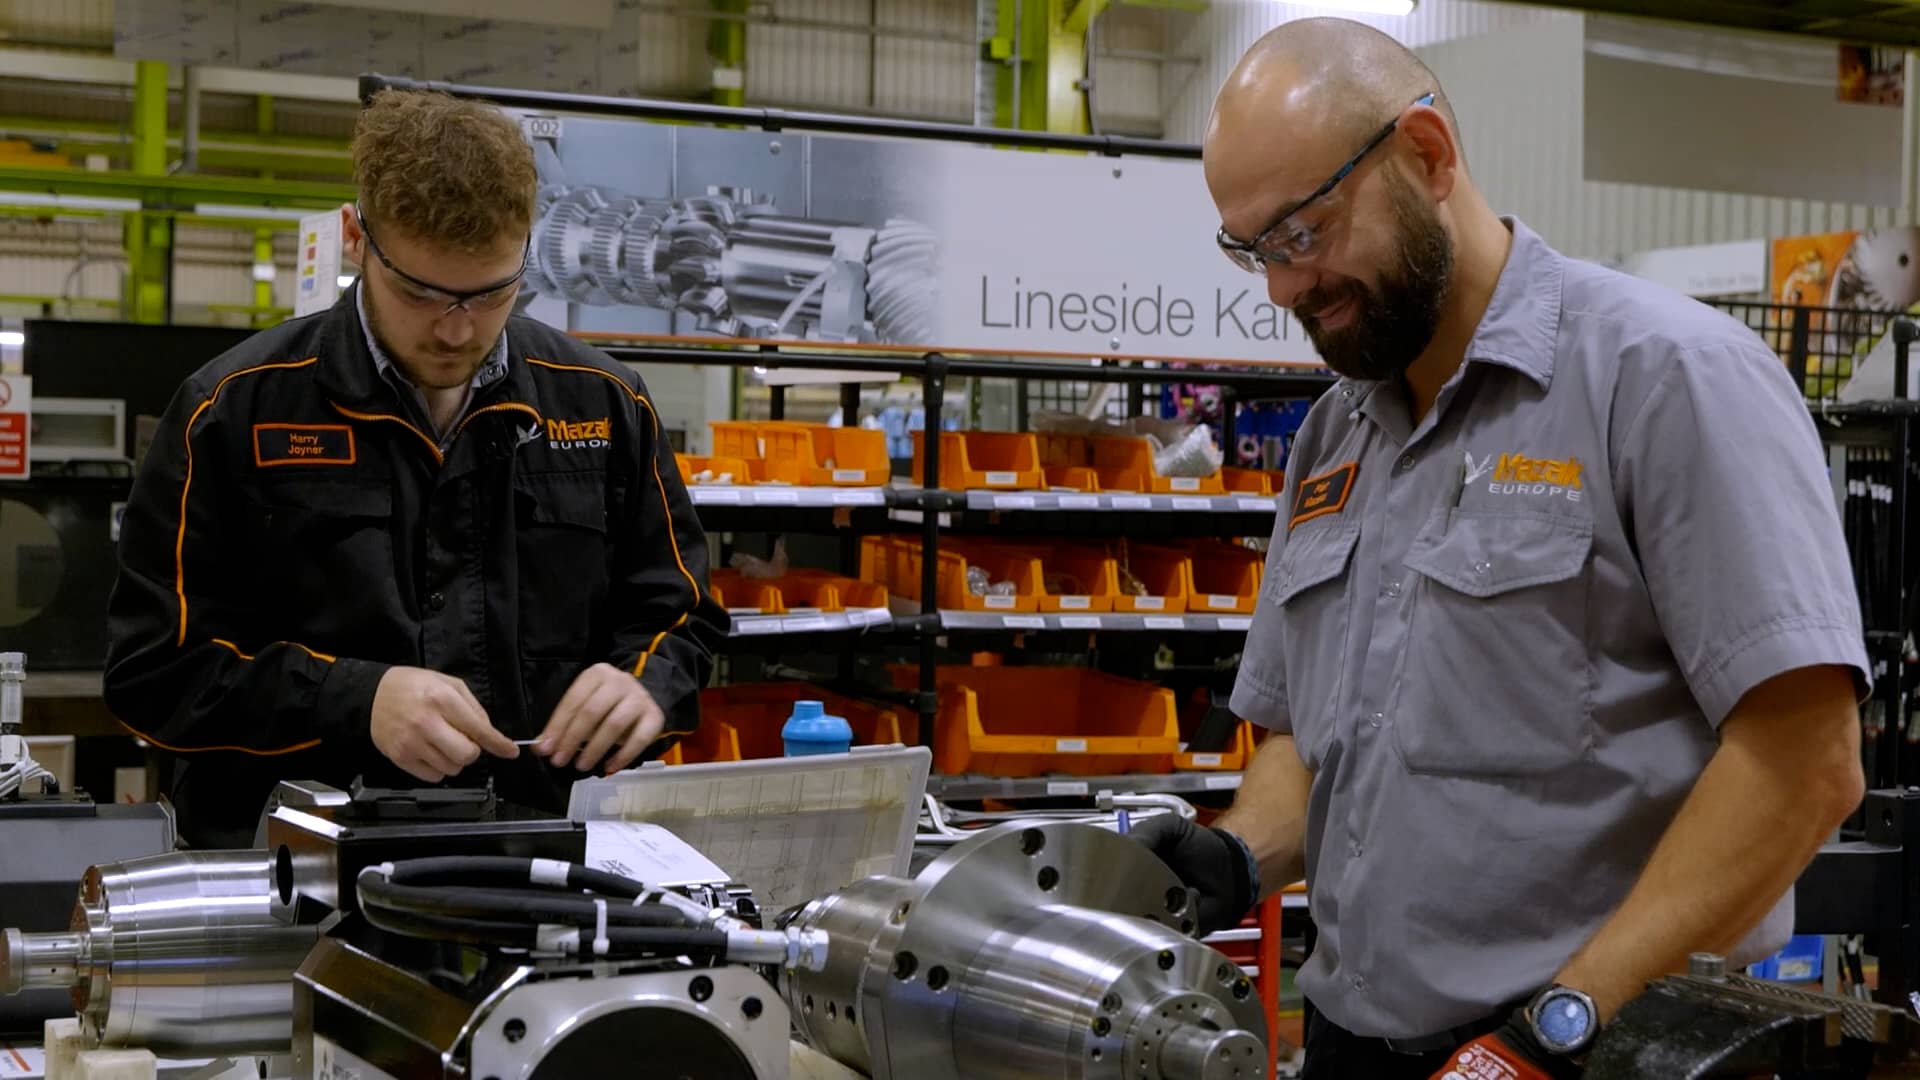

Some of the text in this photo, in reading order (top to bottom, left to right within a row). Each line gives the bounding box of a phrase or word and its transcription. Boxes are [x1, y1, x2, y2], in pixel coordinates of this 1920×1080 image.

[531, 120, 559, 136] 002
[981, 275, 1195, 337] Lineside
[289, 433, 319, 445] Harry
[287, 444, 325, 456] Joyner
[1494, 452, 1584, 490] Mazak
[1488, 482, 1582, 502] EUROPE
